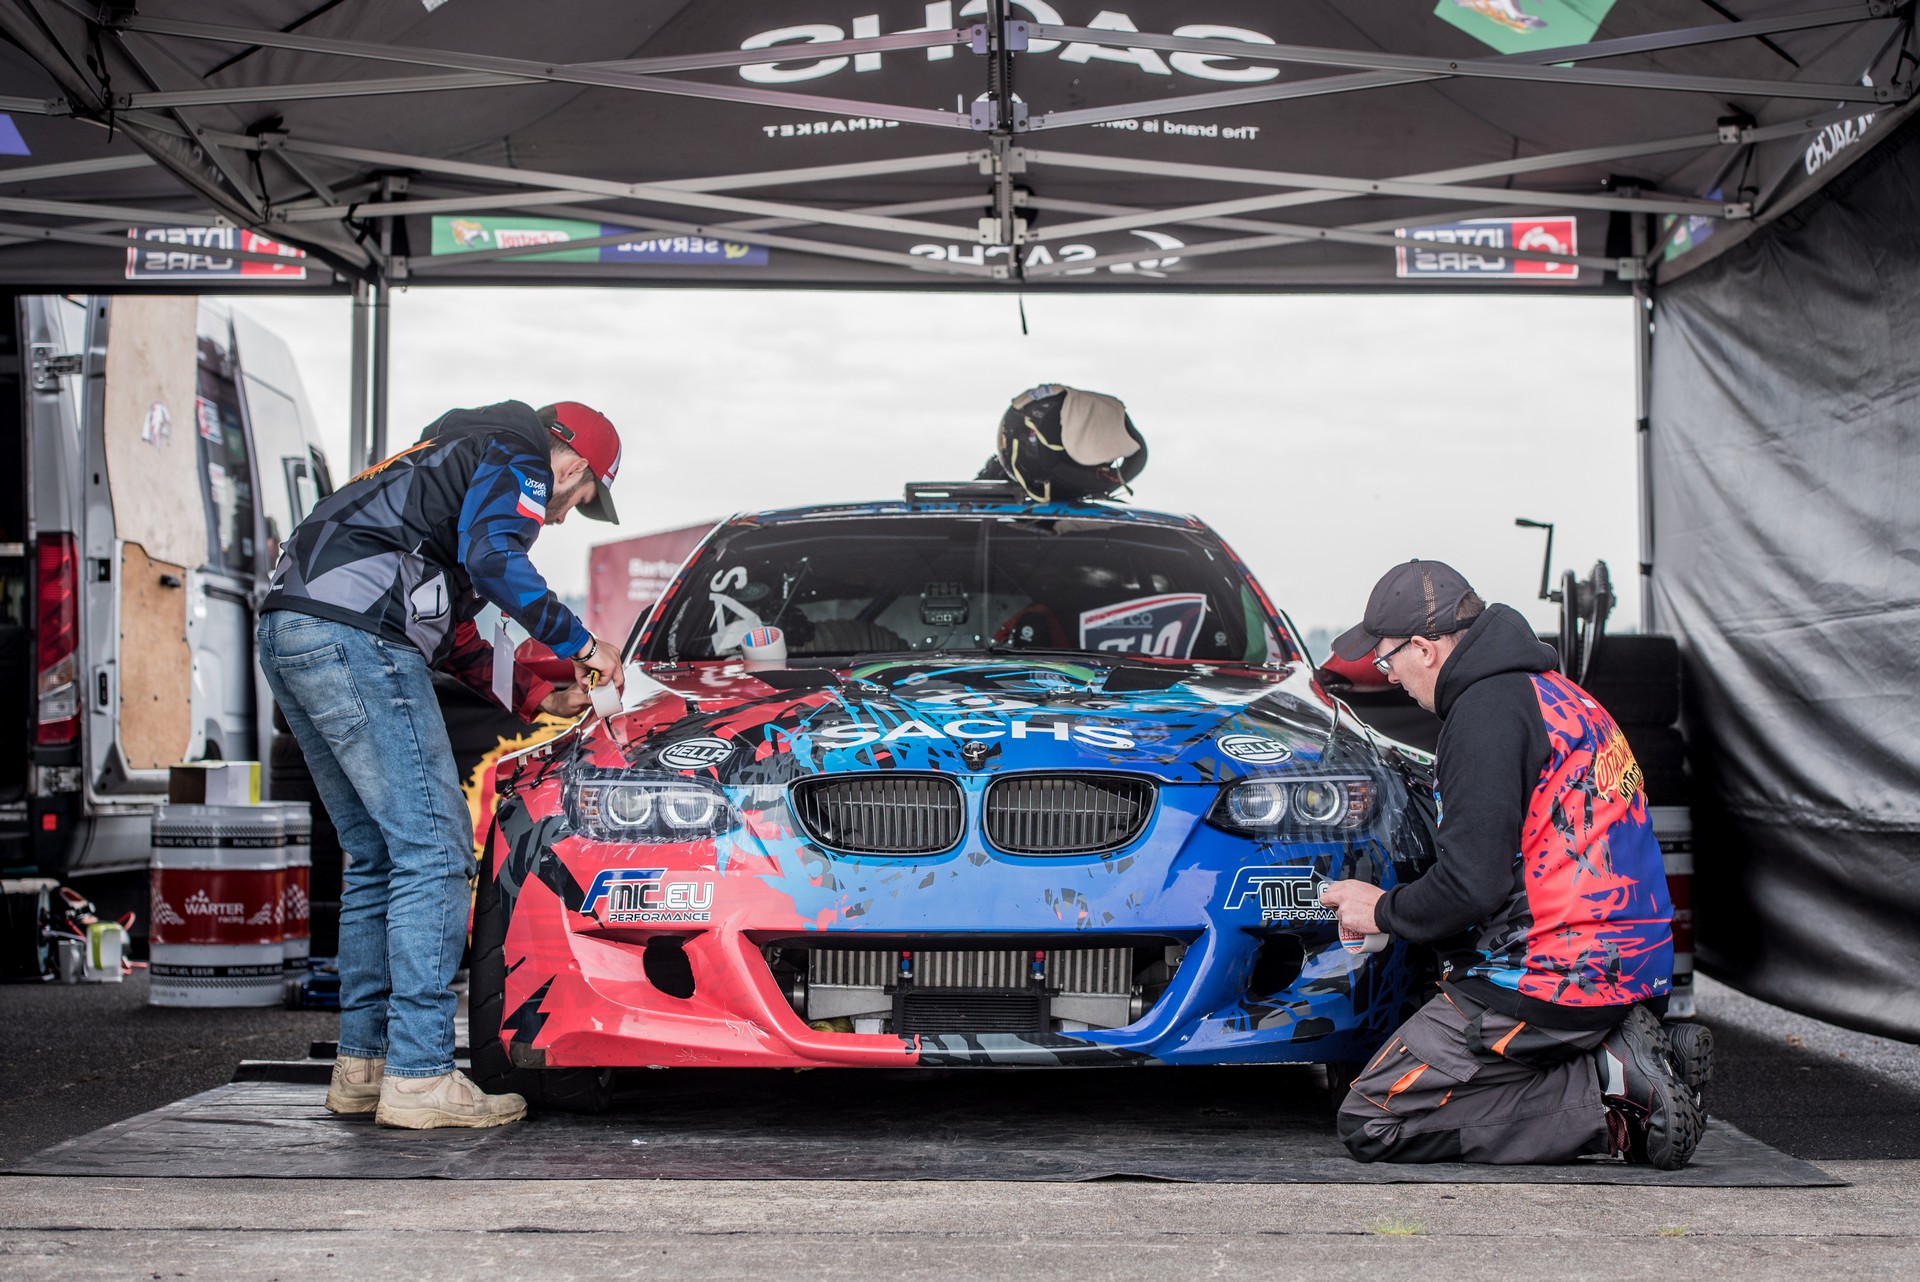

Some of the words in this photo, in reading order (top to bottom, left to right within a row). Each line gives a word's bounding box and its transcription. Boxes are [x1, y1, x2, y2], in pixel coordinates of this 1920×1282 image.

[818, 719, 1136, 749] SACHS
[665, 745, 733, 763] HELLA
[1224, 741, 1291, 755] HELLA
[183, 902, 245, 916] WARTER
[1261, 909, 1339, 921] PERFORMA
[608, 911, 712, 923] PERFORMANCE
